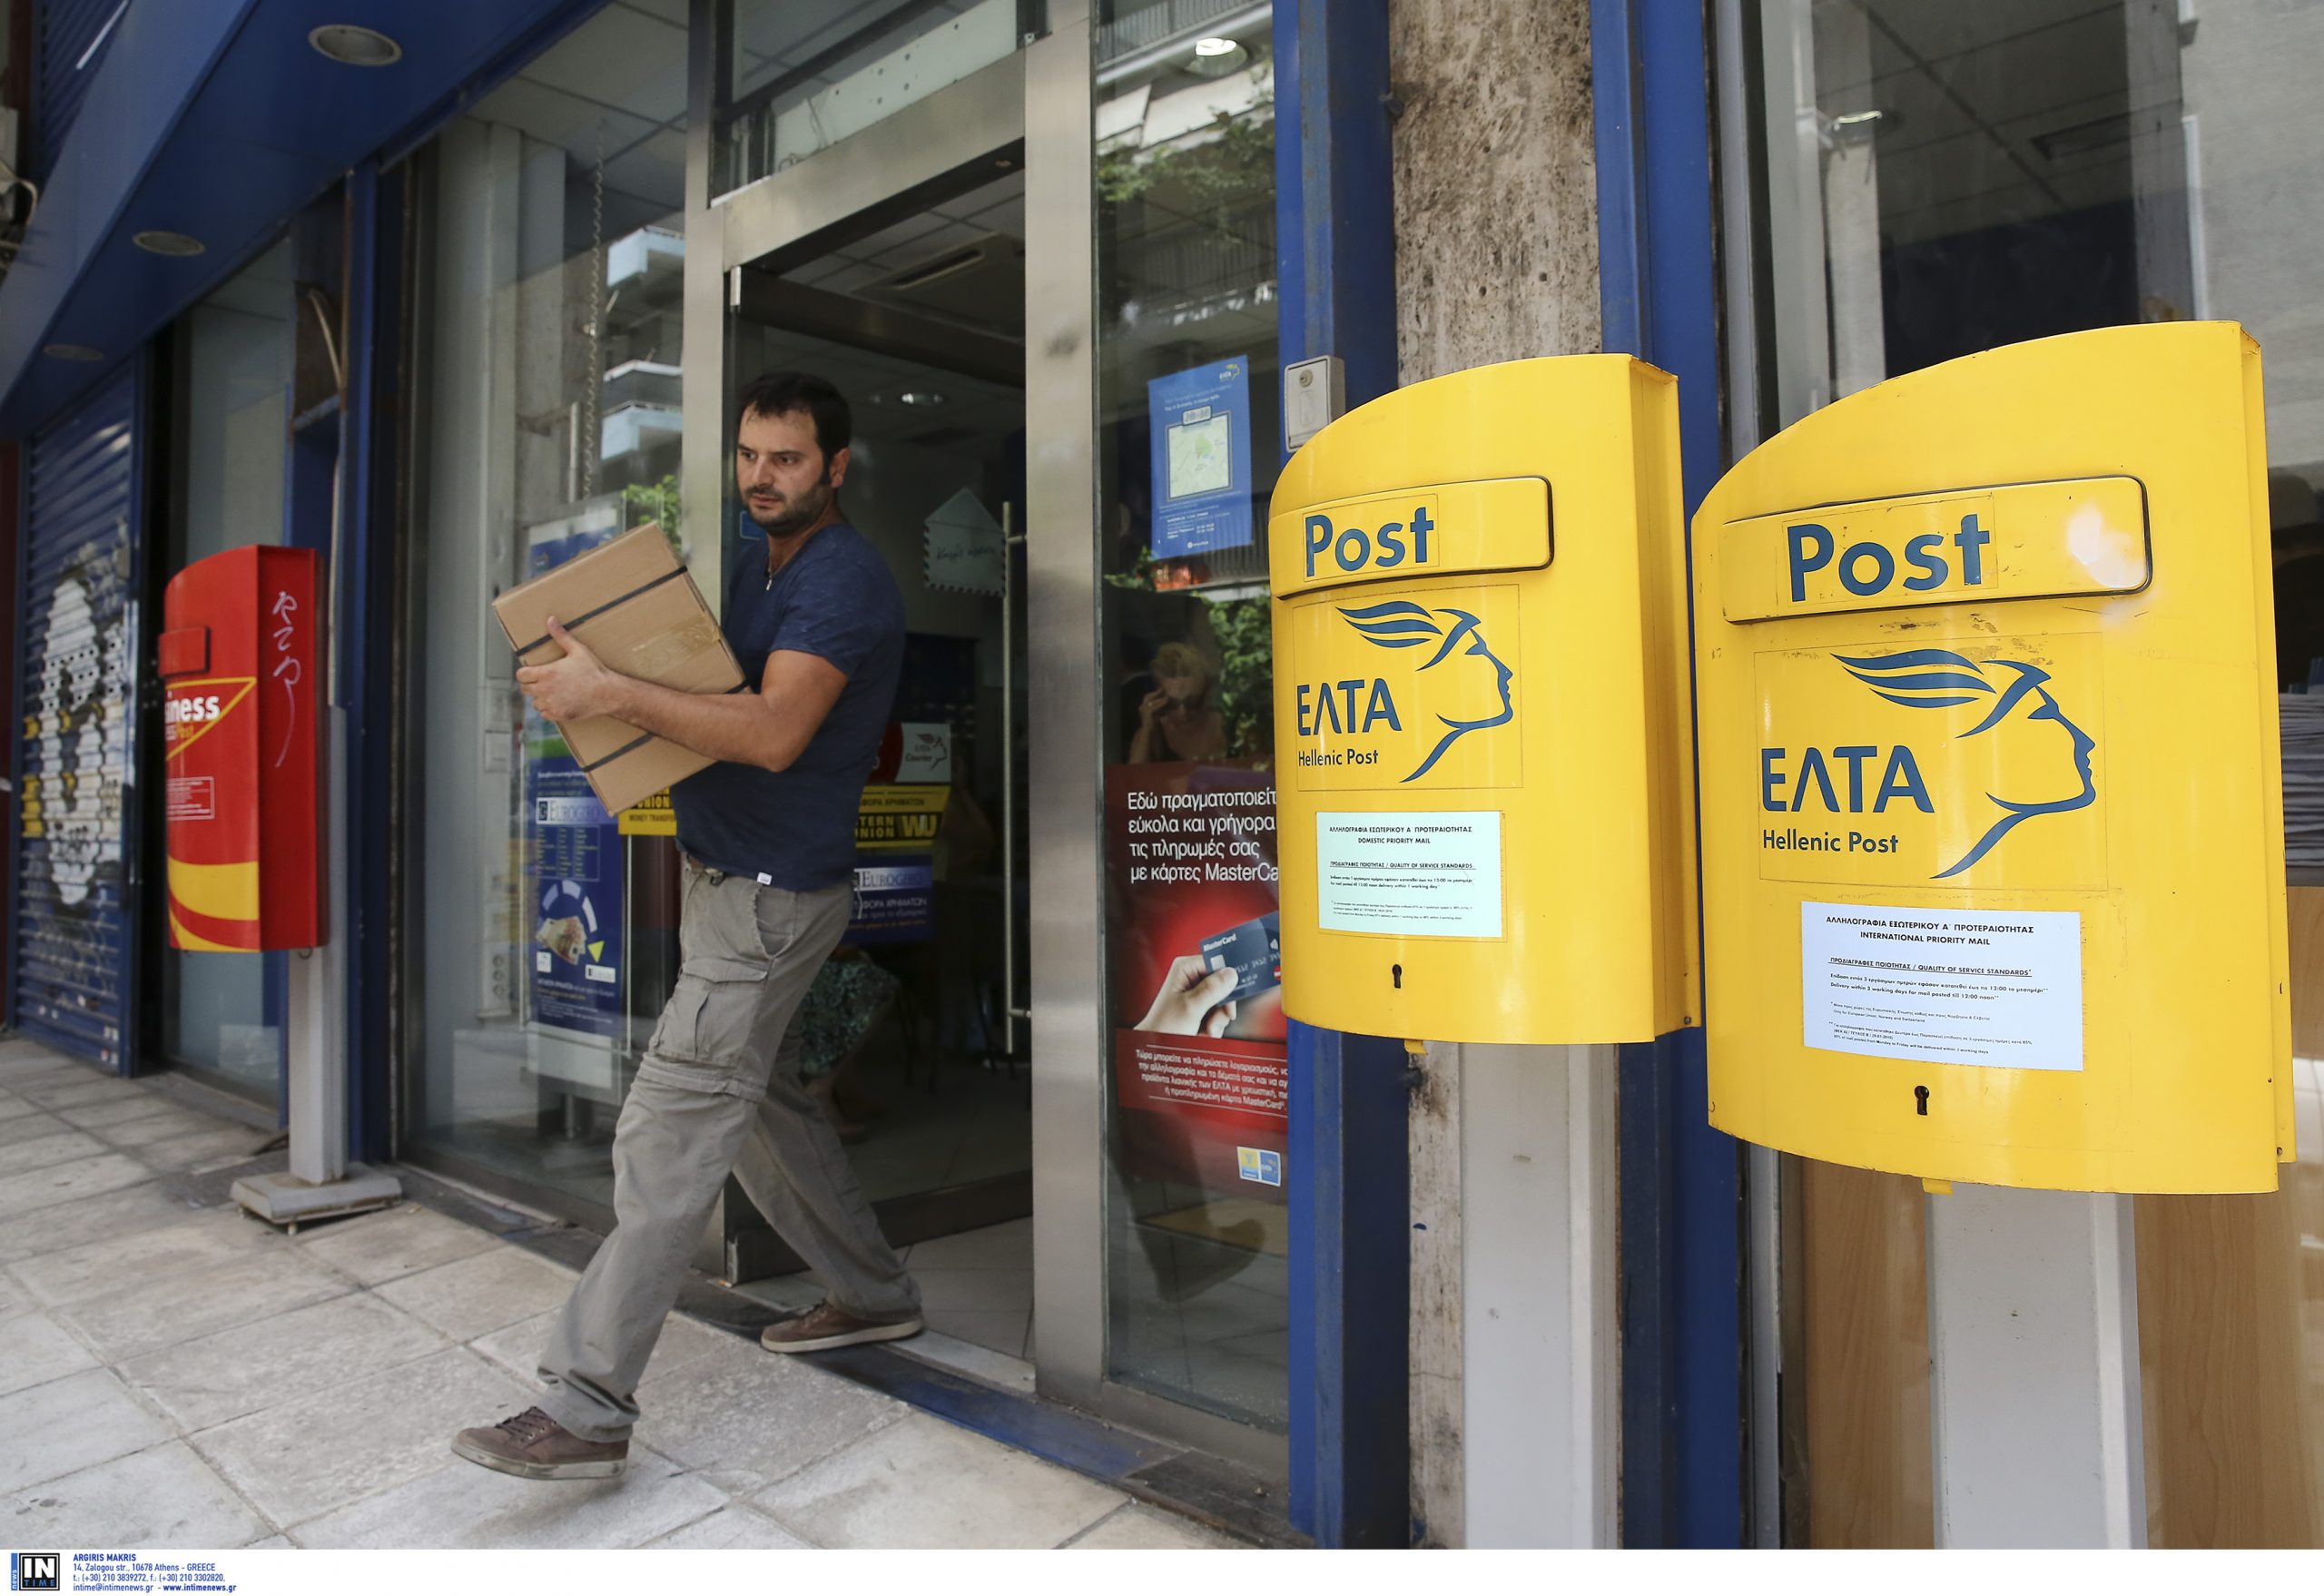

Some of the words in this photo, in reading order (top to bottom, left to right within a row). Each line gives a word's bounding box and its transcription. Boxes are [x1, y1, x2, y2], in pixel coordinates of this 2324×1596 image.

[1305, 507, 1435, 577] Post
[1787, 513, 1990, 603] Post
[1297, 677, 1402, 736] ΕΛΤΑ
[1298, 749, 1343, 767] Hellenic
[1347, 748, 1379, 765] Post
[1761, 744, 1935, 813] ΕΛΤΑ
[1128, 792, 1158, 810] Εδώ
[856, 815, 894, 827] TERN
[1128, 816, 1179, 833] εύκολα
[1183, 818, 1206, 832] και
[1209, 815, 1275, 835] γρήγορα
[1129, 842, 1148, 859] τις
[1152, 839, 1225, 860] πληρωμές
[1229, 842, 1260, 859] σας
[1763, 829, 1841, 852] Hellenic
[1848, 831, 1899, 853] Post
[1130, 868, 1147, 883] με
[1151, 863, 1201, 884] κάρτες
[1206, 862, 1278, 882] MasterCa
[1827, 916, 1886, 927] ΑΛΛΗΛΟΓΡΑΦΙΑ
[1889, 921, 1939, 931] ΕΞΩΤΕΡΙΚΟΥ
[1954, 924, 2034, 933] ΠΡΟΤΕΡΑΙΟΤΗΤΑΣ
[1860, 931, 1924, 942] INTERNATIONAL
[1926, 936, 1965, 944] PRIORITY
[1830, 957, 1875, 966] ΠΡΟΔΙΑΓΡΑΦΕΣ
